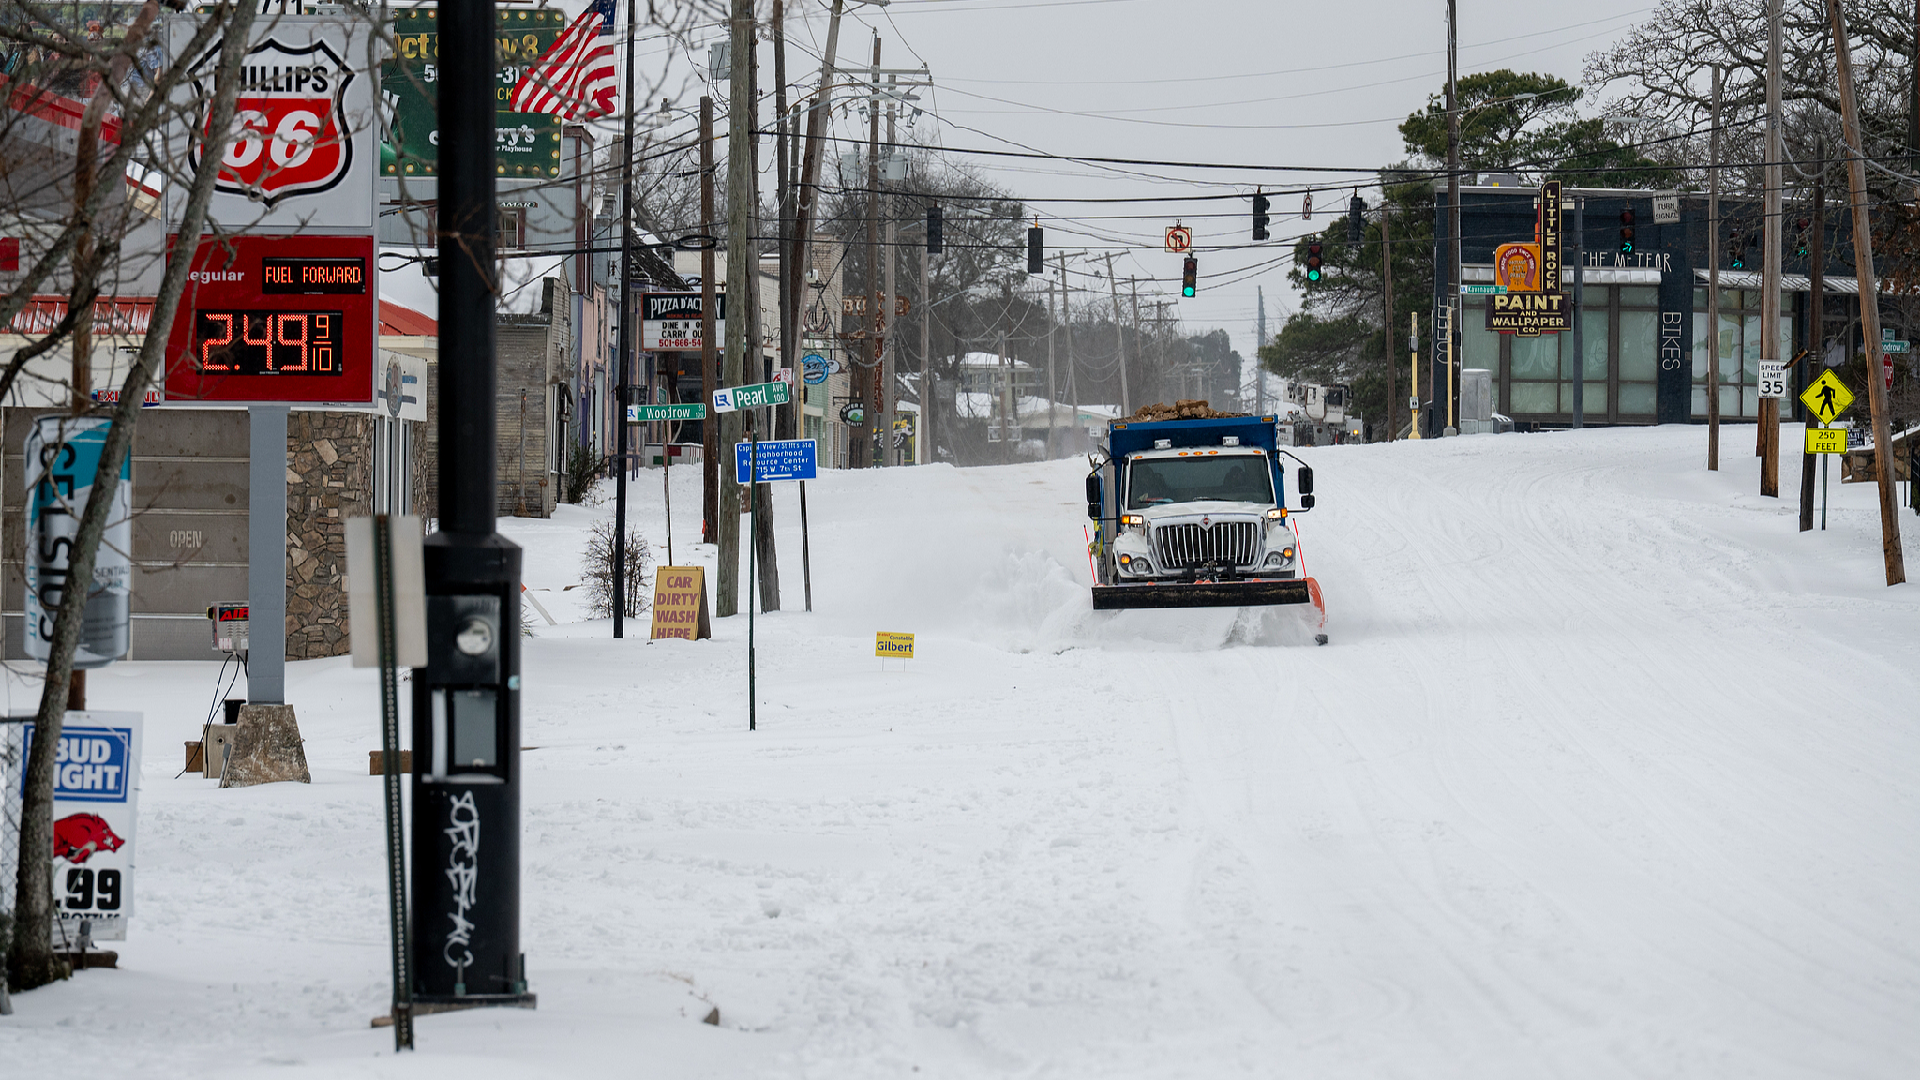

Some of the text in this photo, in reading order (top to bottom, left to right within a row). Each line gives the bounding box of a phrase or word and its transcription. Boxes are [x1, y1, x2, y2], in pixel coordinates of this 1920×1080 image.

[214, 66, 328, 92] ILLIPS
[221, 110, 321, 168] 66
[501, 144, 533, 153] Playhouse
[1657, 202, 1675, 211] TURN
[1546, 189, 1556, 247] LITTLE
[265, 266, 361, 284] FUEL FORWARD
[1546, 251, 1557, 290] ROCK
[186, 271, 245, 285] egular
[650, 295, 722, 320] PIZZA D'ACTN
[1494, 294, 1563, 310] PAINT
[662, 321, 679, 330] DINE
[1492, 317, 1564, 327] WALLPAPER
[661, 329, 703, 339] CARRY OU
[1662, 310, 1682, 371] BIKES
[202, 313, 308, 372] 2.49
[658, 338, 703, 348] 501-666-54
[1882, 342, 1901, 352] odrow
[1884, 365, 1893, 380] TOP
[1761, 380, 1784, 394] 35
[97, 390, 121, 402] EXI
[736, 385, 768, 407] Pearl
[772, 383, 784, 394] Ave
[646, 406, 691, 419] Woodrow
[1818, 431, 1836, 440] 250
[738, 444, 760, 453] Capil
[1815, 442, 1837, 451] FEET
[742, 458, 778, 467] Reource
[169, 530, 202, 548] OPEN
[666, 576, 693, 589] CAR
[656, 593, 699, 606] DIRTY
[656, 610, 696, 624] WASH
[28, 612, 38, 640] FIT
[656, 627, 691, 639] HERE
[877, 640, 913, 653] Gilbert
[54, 738, 111, 763] BUD
[53, 764, 121, 790] IGHT
[54, 868, 121, 911] .99
